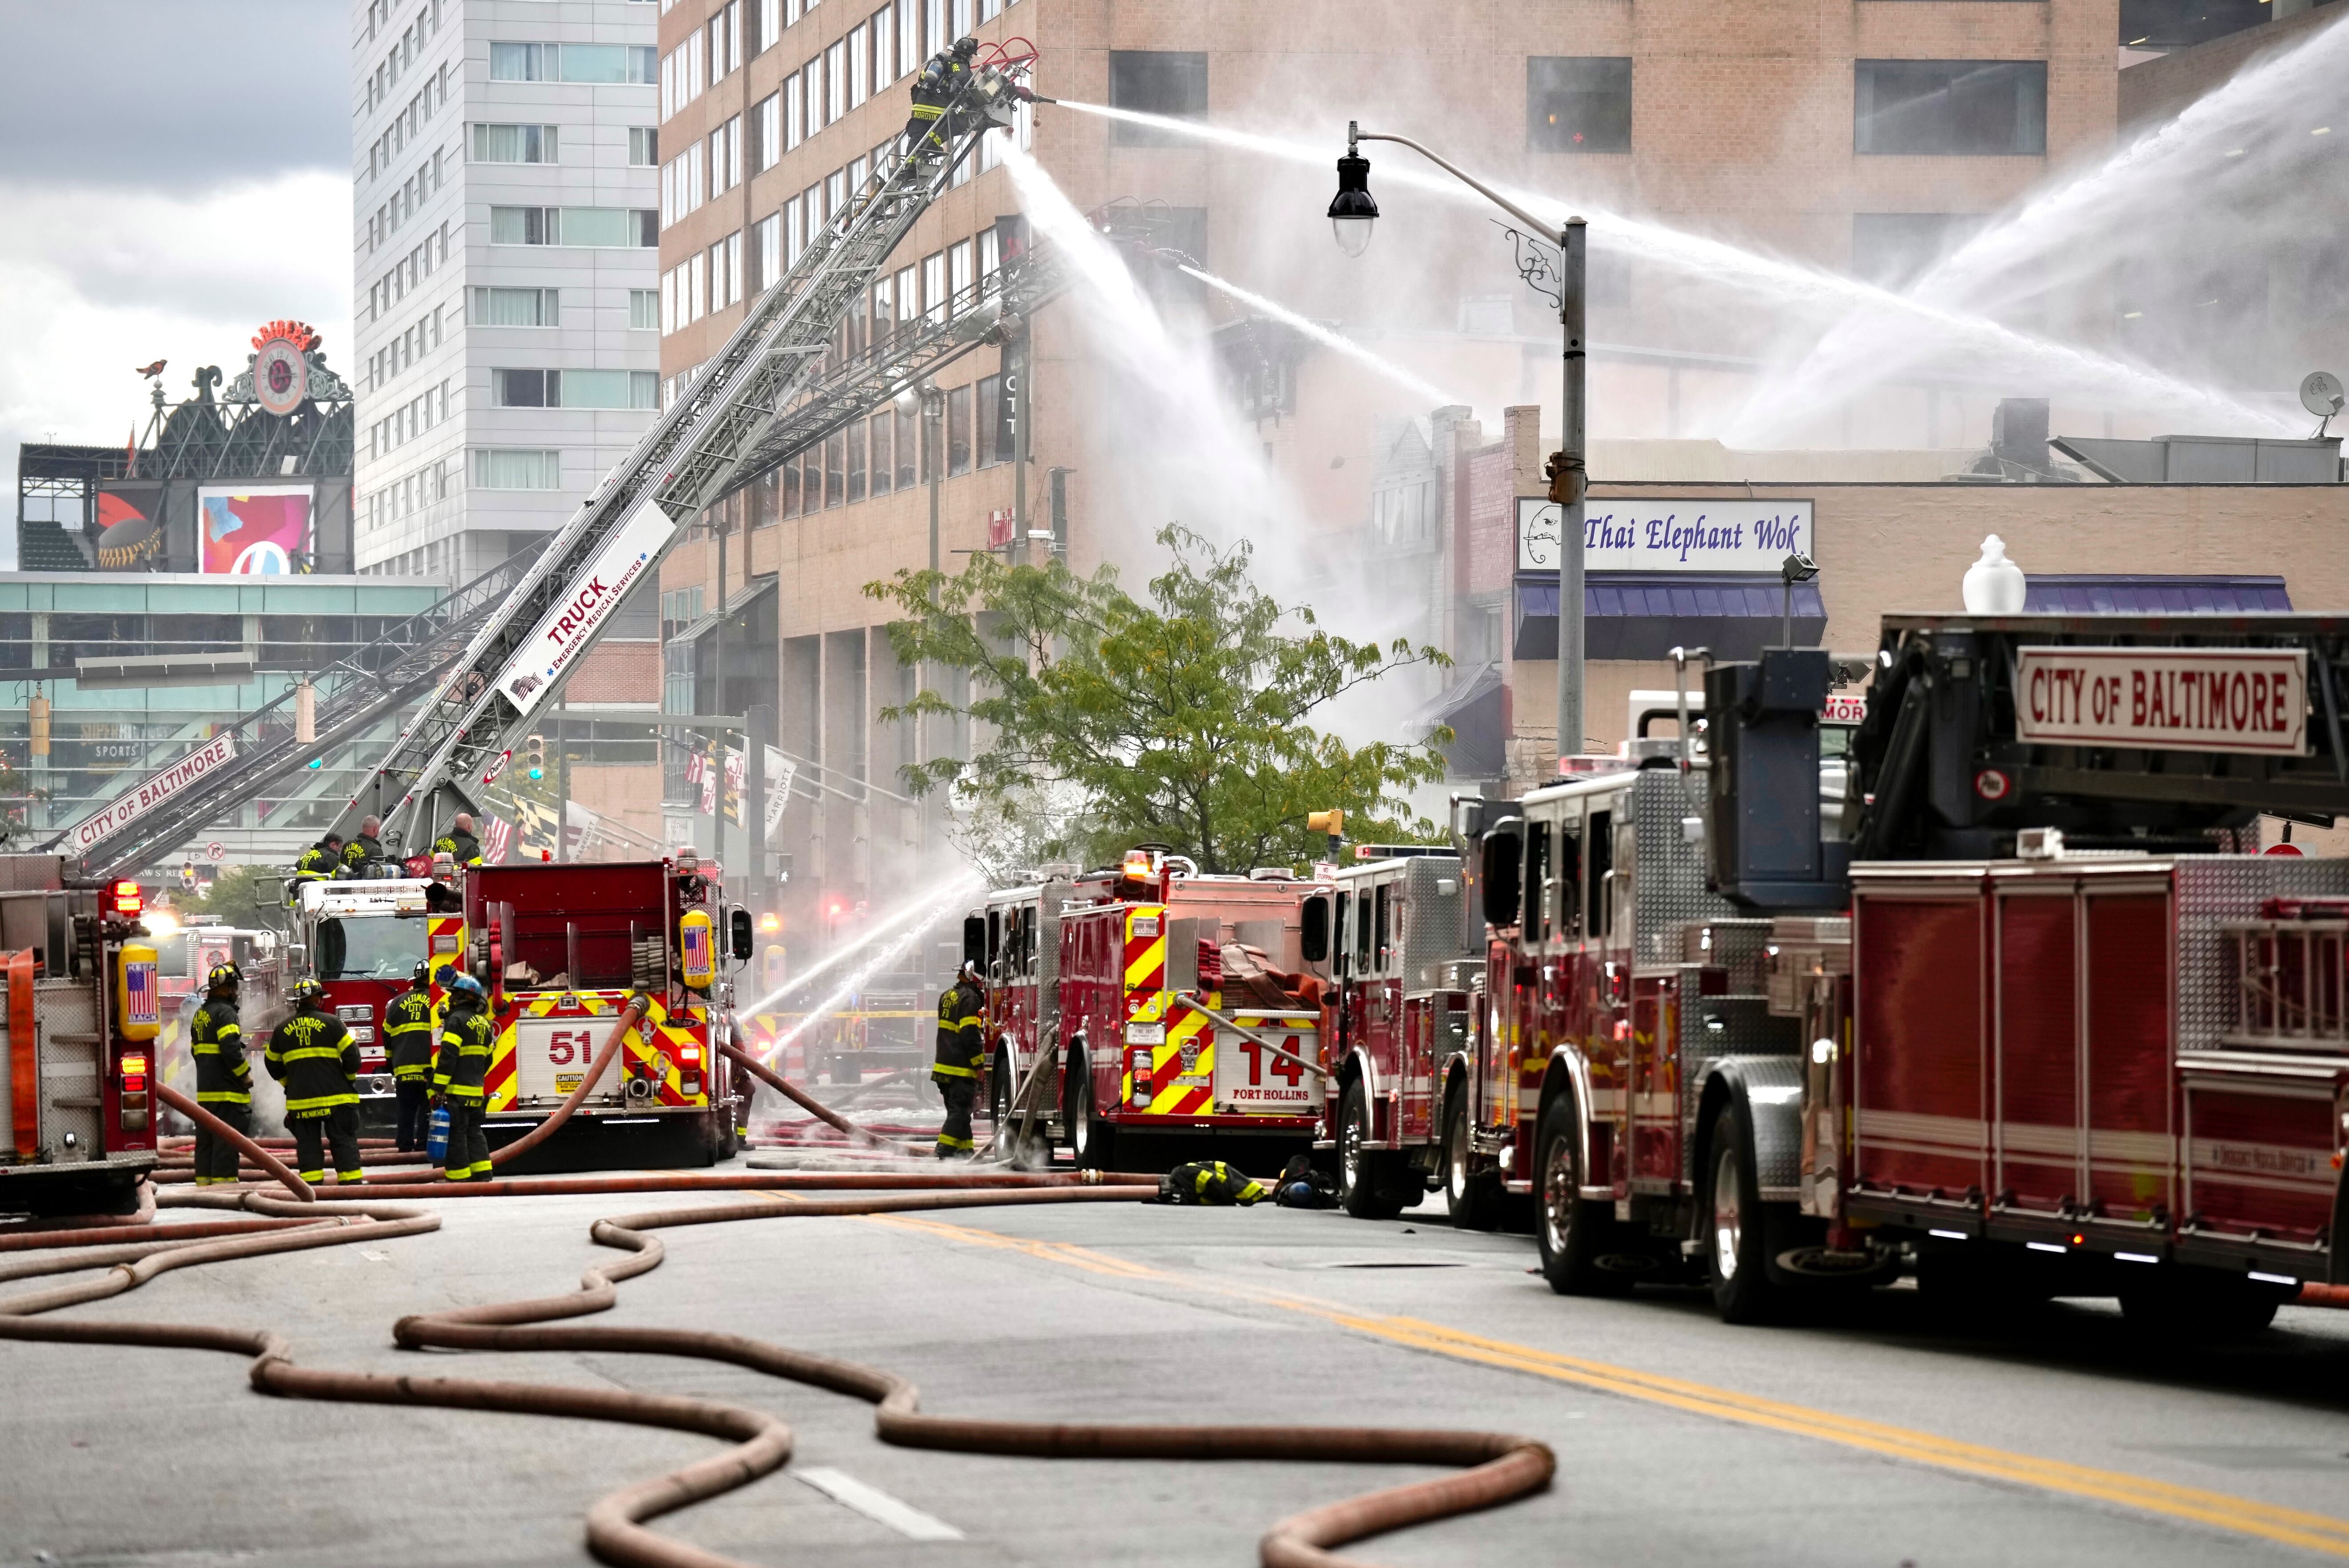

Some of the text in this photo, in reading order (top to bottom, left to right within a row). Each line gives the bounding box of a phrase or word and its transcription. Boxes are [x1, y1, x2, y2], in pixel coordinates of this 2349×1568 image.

[1585, 514, 1804, 561] Thai Elephant Wok
[547, 575, 609, 646] TRUCK
[552, 560, 642, 670] EMERGENCY MEDICAL SERVICES
[2030, 667, 2288, 731] CITY OF BALTIMORE
[96, 746, 136, 757] SPORTS
[489, 757, 505, 778] Pierce
[81, 742, 226, 844] CITY OF BALTIMORE
[766, 768, 791, 823] MARRIOTT
[409, 1003, 423, 1012] CITY
[411, 1012, 421, 1020] FD
[283, 1017, 326, 1036] BALTIMORE
[295, 1027, 311, 1037] CITY
[299, 1036, 311, 1046] FD
[549, 1031, 591, 1065] 51
[1240, 1035, 1303, 1086] 14
[1233, 1090, 1308, 1100] FORT HOLLINS
